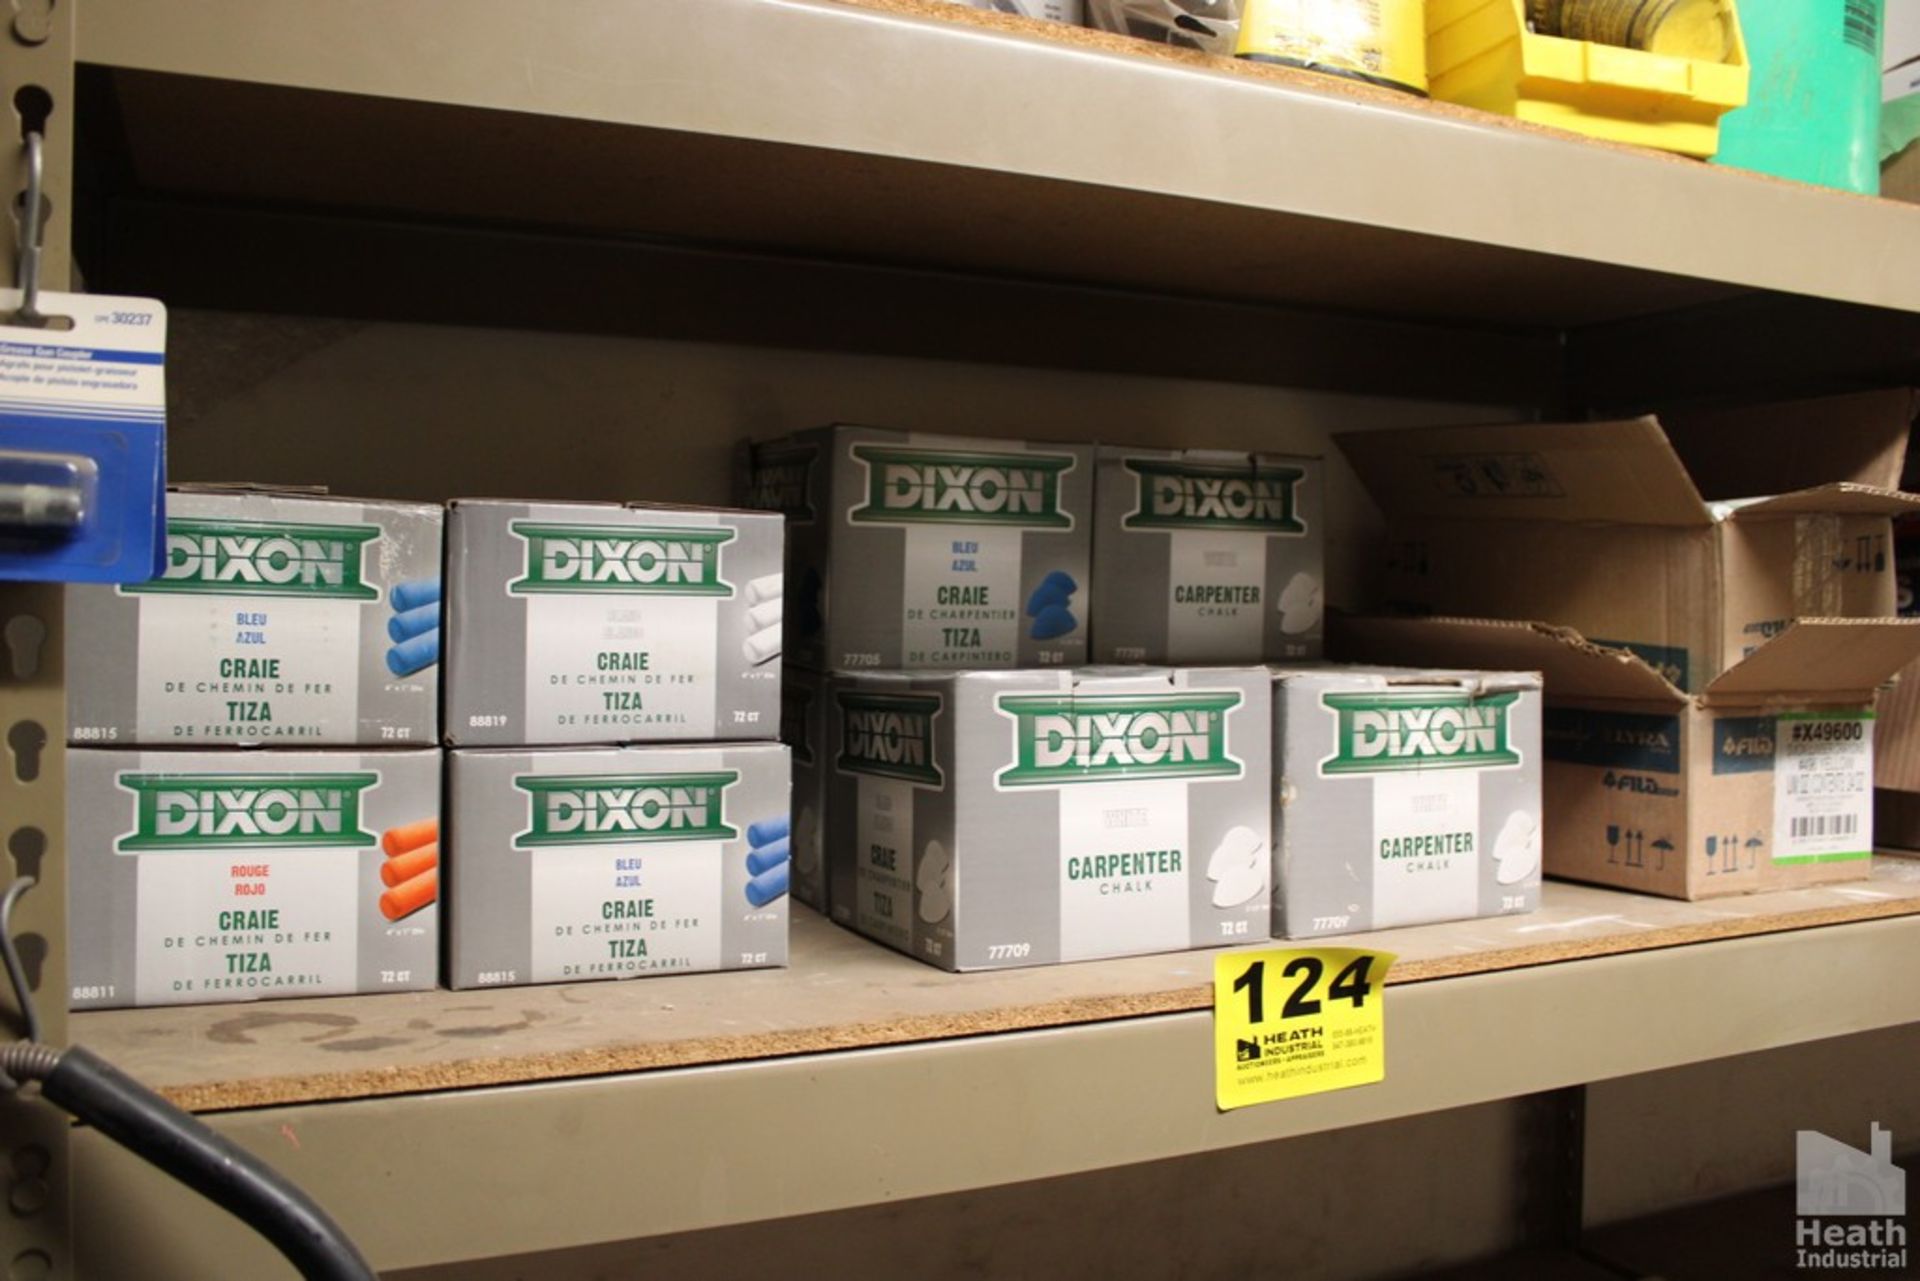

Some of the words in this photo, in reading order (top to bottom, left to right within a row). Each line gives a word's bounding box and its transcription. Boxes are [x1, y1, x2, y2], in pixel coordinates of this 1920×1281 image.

[111, 311, 152, 326] 30237
[885, 463, 1044, 513] DIXON
[1154, 474, 1284, 519] DIXON
[952, 541, 978, 554] BLEU
[161, 535, 343, 585] DIXON
[542, 539, 704, 583] DIXON
[951, 560, 978, 572] AZUL
[937, 586, 989, 606] CRAIE
[1175, 585, 1261, 604] CARPENTER
[237, 613, 267, 626] BLEU
[908, 608, 923, 620] DE
[930, 608, 1016, 620] CHARPENTIER
[1198, 606, 1239, 617] CHALK
[236, 632, 266, 645] AZUL
[942, 627, 982, 648] TIZA
[597, 652, 649, 671] CRAIE
[844, 653, 881, 666] 77705
[910, 651, 924, 661] DE
[931, 651, 1012, 662] CARPINTERO
[220, 659, 280, 679] CRAIE
[165, 682, 186, 693] DE
[196, 682, 265, 694] CHEMIN
[276, 683, 295, 694] DE
[305, 683, 332, 694] FER
[550, 675, 567, 685] DE
[577, 675, 636, 685] CHEMIN
[645, 675, 661, 685] DE
[671, 674, 695, 684] FER
[603, 692, 643, 710] TIZA
[226, 702, 272, 722] TIZA
[558, 715, 574, 725] DE
[584, 713, 687, 725] FERROCARRIL
[733, 710, 745, 722] 72
[73, 727, 118, 740] 88815
[174, 725, 194, 737] DE
[205, 725, 323, 737] FERROCARRIL
[381, 726, 395, 739] 72
[848, 712, 925, 766] DIXON
[1035, 710, 1210, 767] DIXON
[1353, 705, 1497, 758] DIXON
[1792, 721, 1863, 743] #X49600
[156, 788, 342, 836] DIXON
[547, 786, 707, 832] DIXON
[1380, 832, 1474, 860] CARPENTER
[231, 865, 270, 877] ROUGE
[615, 859, 642, 870] BLEU
[1068, 850, 1182, 880] CARPENTER
[1406, 861, 1449, 874] CHALK
[234, 884, 266, 896] ROJO
[615, 876, 642, 887] AZUL
[1100, 881, 1153, 895] CHALK
[602, 899, 654, 920] CRAIE
[219, 910, 280, 931] CRAIE
[556, 926, 573, 936] DE
[582, 921, 641, 935] CHEMIN
[650, 920, 666, 930] DE
[675, 918, 699, 928] FER
[1220, 922, 1233, 936] 72
[164, 937, 185, 948] DE
[196, 934, 264, 947] CHEMIN
[275, 933, 294, 944] DE
[305, 931, 332, 941] FER
[608, 938, 648, 958] TIZA
[741, 953, 753, 965] 72
[988, 943, 1031, 960] 77709
[226, 952, 272, 973] TIZA
[564, 965, 580, 975] DE
[590, 957, 691, 974] FERROCARRIL
[173, 980, 193, 991] DE
[205, 974, 323, 989] FERROCARRIL
[381, 971, 395, 983] 72
[72, 986, 116, 1000] 88811
[1234, 955, 1376, 1024] 124
[1263, 1026, 1324, 1046] HEATH
[1264, 1039, 1324, 1057] INDUSTRIAL
